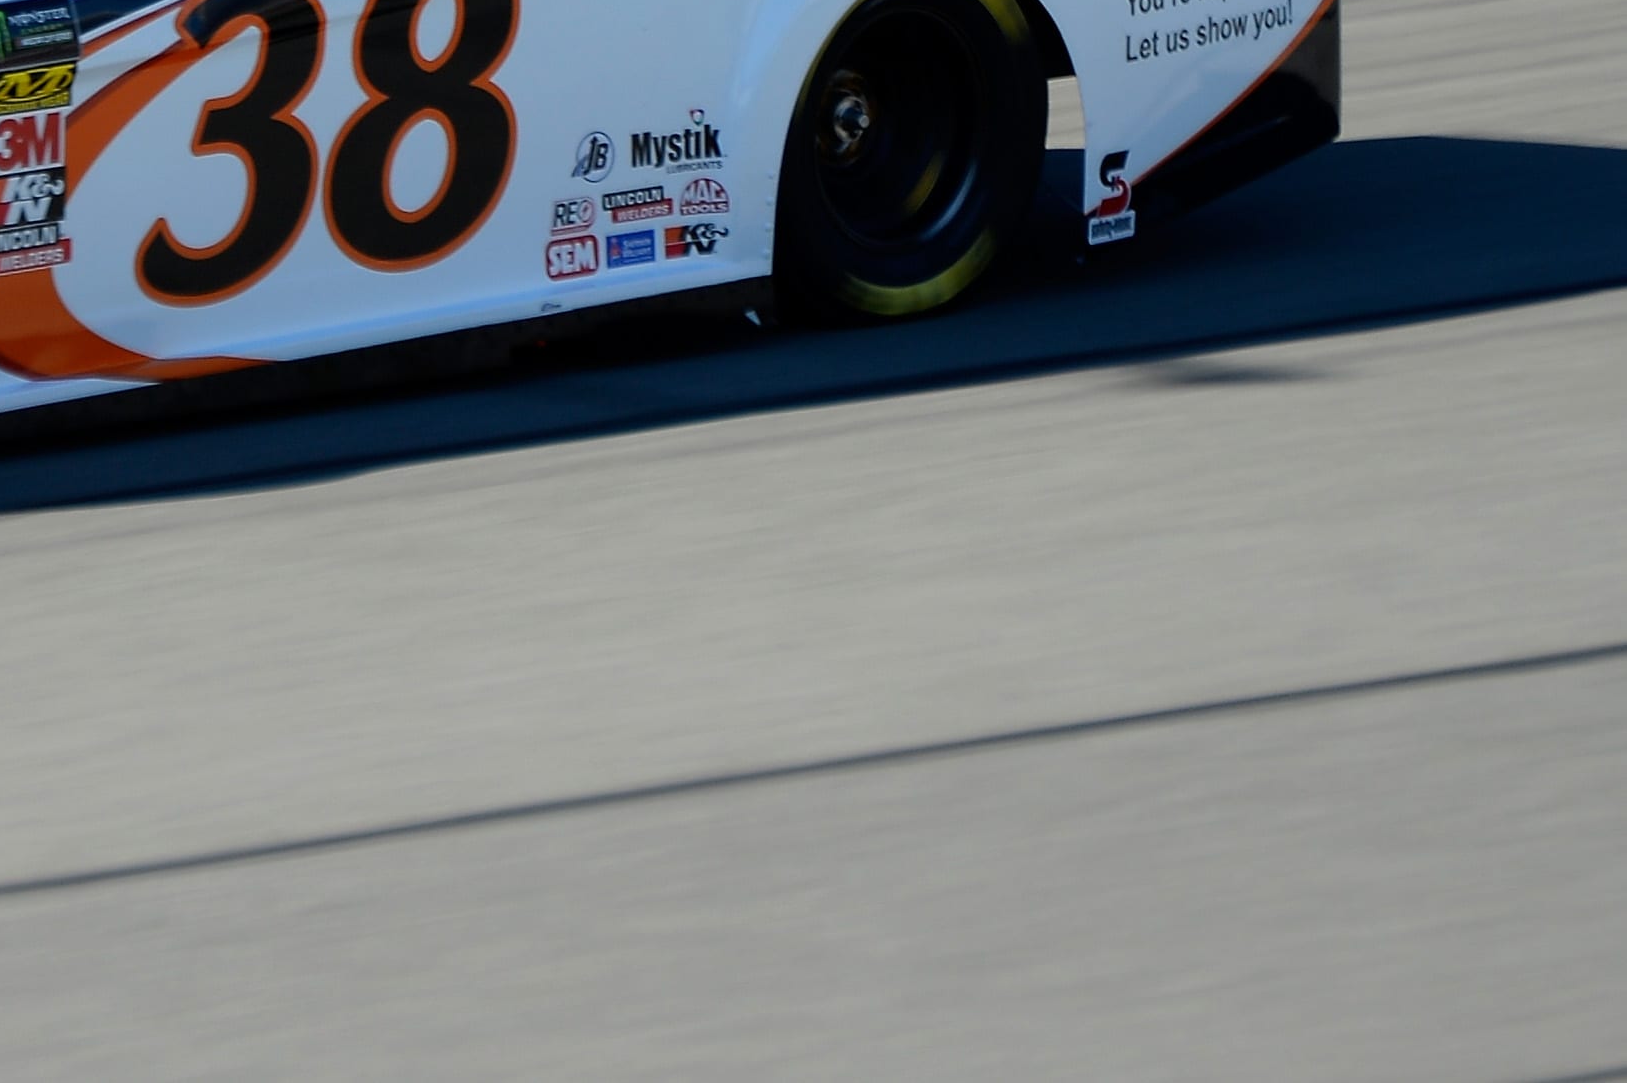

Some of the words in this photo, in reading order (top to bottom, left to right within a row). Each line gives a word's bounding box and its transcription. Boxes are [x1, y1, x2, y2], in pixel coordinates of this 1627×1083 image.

[1126, 30, 1160, 63] Let
[1166, 28, 1191, 54] us
[1196, 15, 1249, 48] show
[630, 123, 722, 168] Mystik
[666, 160, 724, 175] LUBRICANTS
[603, 189, 662, 210] LINCOLN
[684, 180, 728, 205] MAC
[616, 203, 671, 223] WELDERS
[682, 203, 729, 216] TOOLS
[548, 239, 597, 278] SEM
